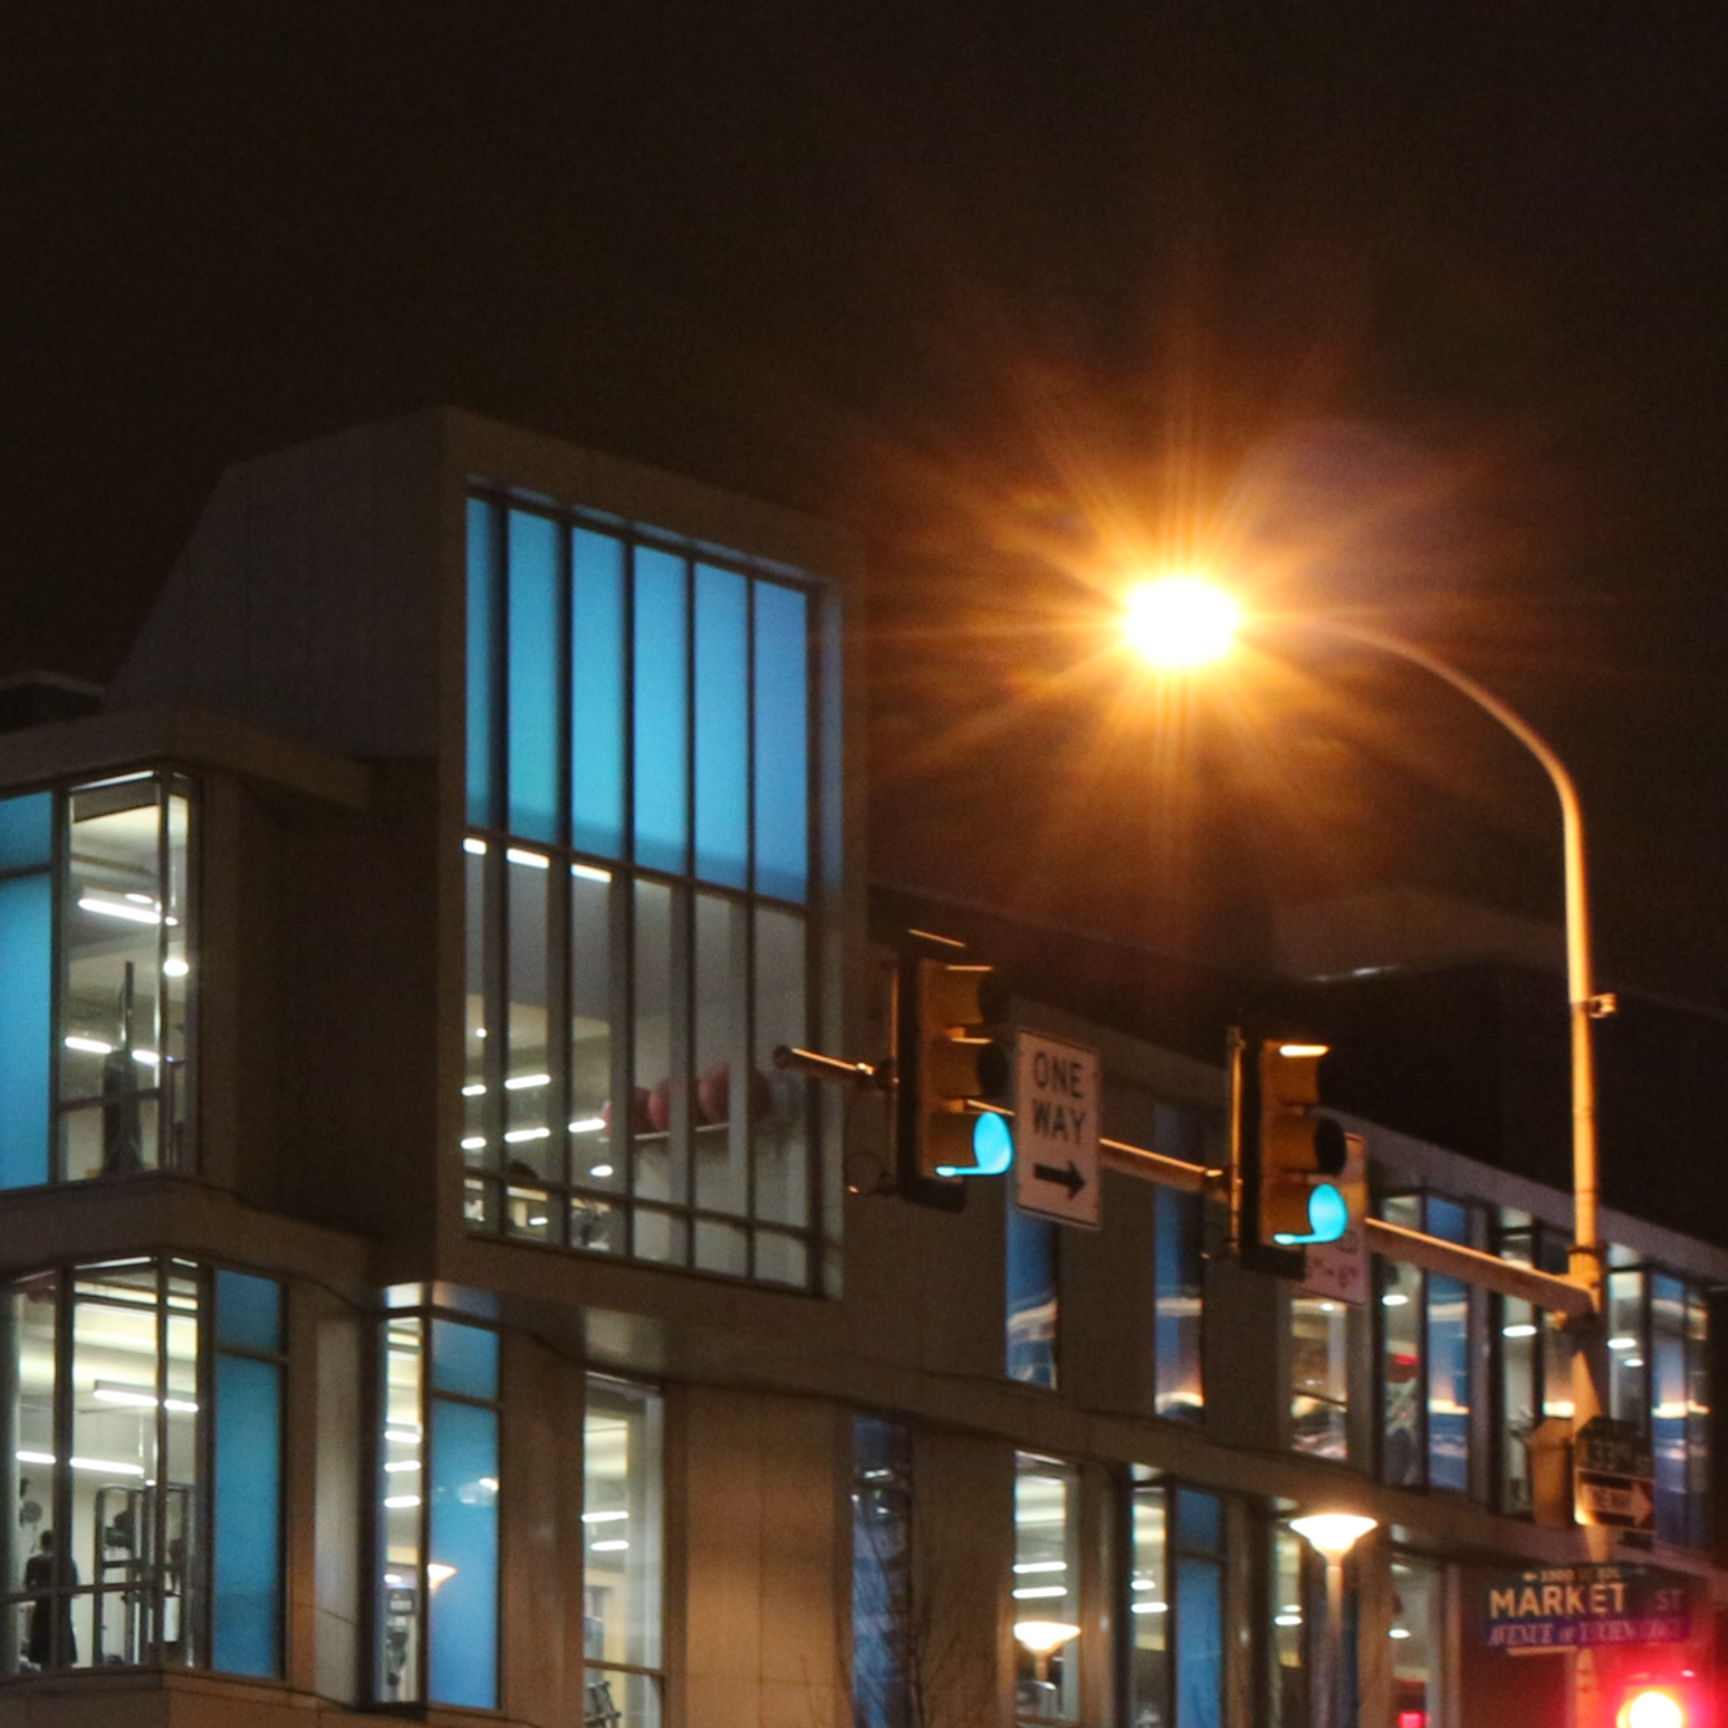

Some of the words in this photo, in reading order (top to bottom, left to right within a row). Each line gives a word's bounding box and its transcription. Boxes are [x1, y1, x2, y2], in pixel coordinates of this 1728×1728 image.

[1033, 1053, 1083, 1098] ONE
[1033, 1098, 1087, 1145] WAY
[1490, 1583, 1627, 1619] MARKET
